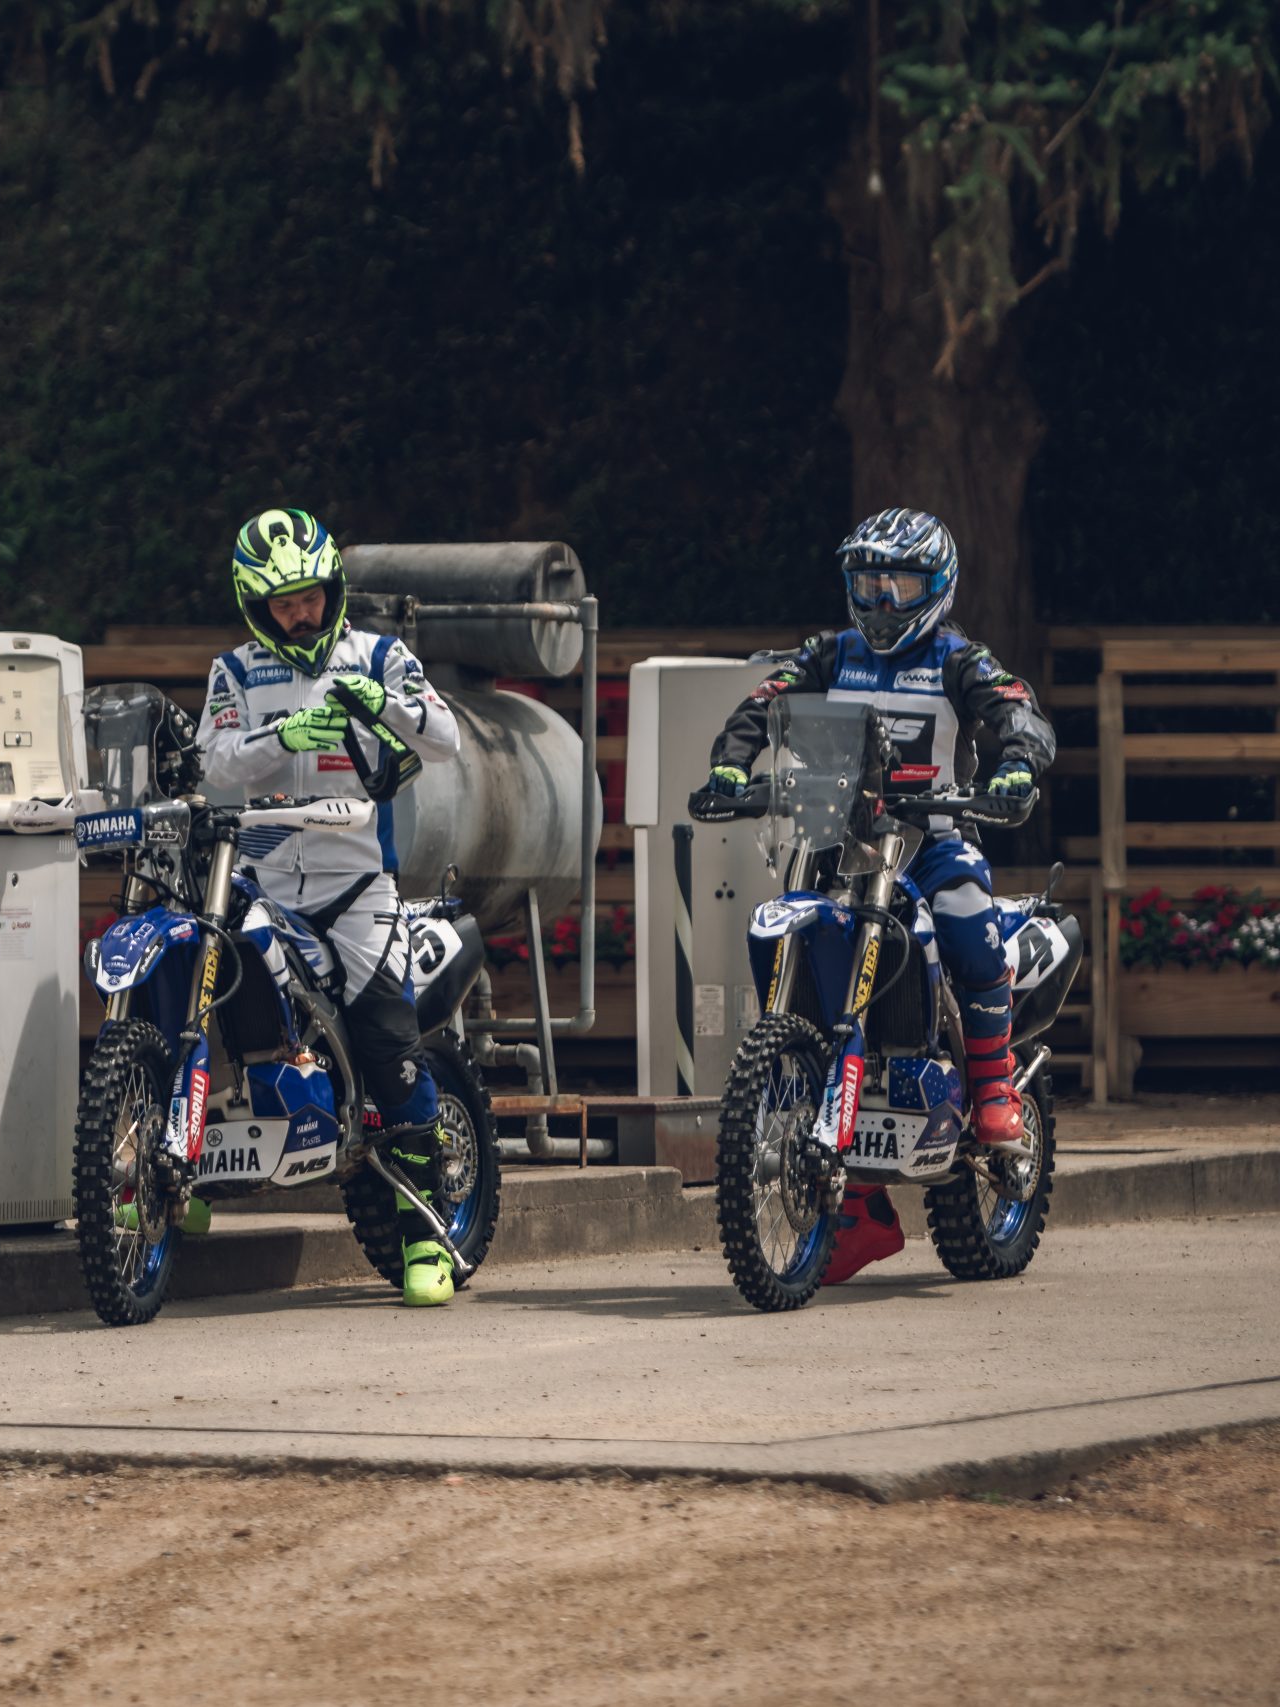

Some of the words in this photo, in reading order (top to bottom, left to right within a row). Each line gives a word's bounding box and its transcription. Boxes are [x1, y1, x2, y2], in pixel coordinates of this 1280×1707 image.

[256, 668, 291, 678] YAMAHA
[845, 670, 878, 683] YAMAHA
[304, 816, 352, 826] Polisport
[962, 809, 1009, 823] Polisport
[86, 815, 136, 835] YAMAHA
[79, 830, 133, 842] RACING
[150, 832, 179, 841] IMS
[861, 939, 880, 978] TECH
[1016, 922, 1055, 986] 4
[202, 947, 220, 991] TECH
[843, 1063, 858, 1130] BORILLI
[191, 1074, 206, 1142] BORILLI
[296, 1121, 319, 1134] YAMAHA
[391, 1147, 431, 1166] IMS
[911, 1151, 951, 1167] IMS
[284, 1155, 332, 1177] IMS
